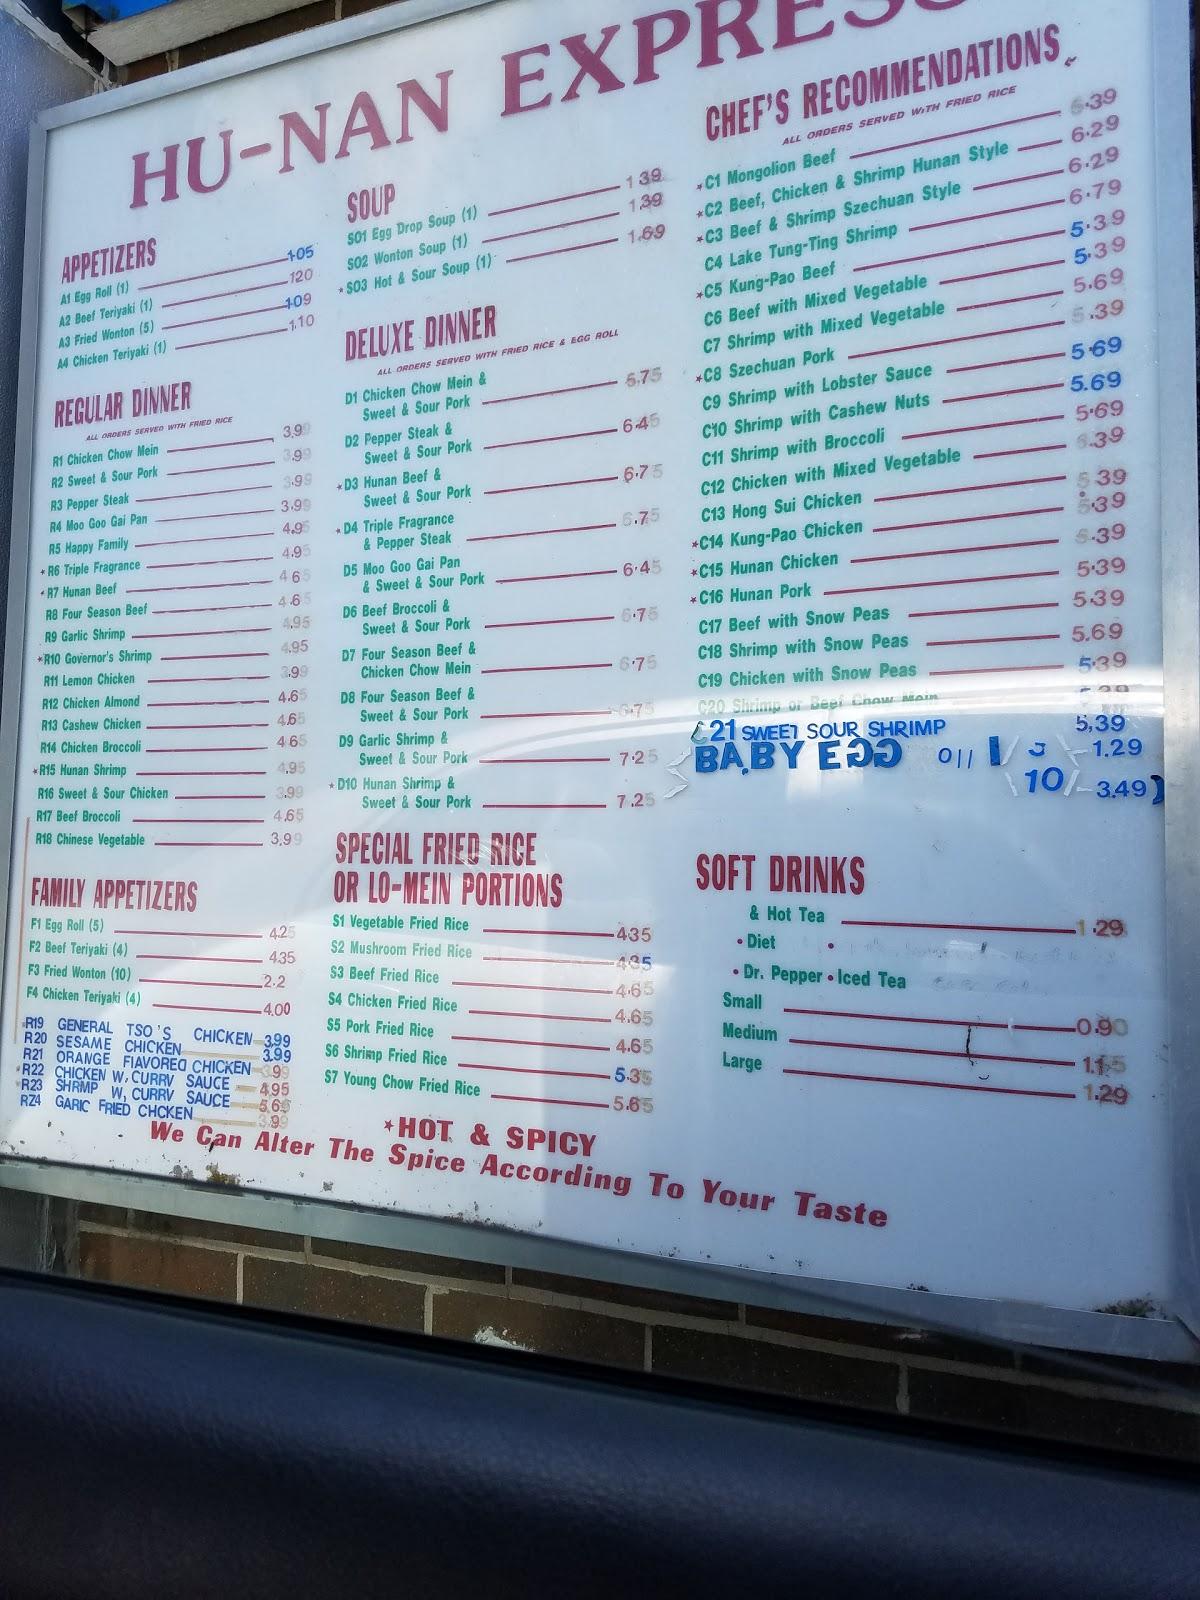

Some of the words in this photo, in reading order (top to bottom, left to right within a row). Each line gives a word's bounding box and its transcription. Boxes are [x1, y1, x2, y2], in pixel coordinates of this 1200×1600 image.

[706, 88, 790, 142] CHEF'S
[803, 23, 1060, 120] RECOMMENDATIONS
[782, 135, 801, 146] ALL
[807, 122, 853, 140] ORDERS
[858, 111, 905, 128] SERVED
[945, 93, 982, 108] FRIED
[987, 85, 1017, 99] RICE
[130, 69, 454, 209] HU-NAN
[347, 183, 396, 224] SOUP
[61, 237, 157, 284] APPETIZERS
[705, 255, 723, 272] C4
[730, 249, 762, 267] Lake
[769, 235, 838, 259] Tung-Ting
[846, 224, 898, 244] Shrimp
[374, 274, 392, 290] Hot
[398, 271, 405, 285] &
[411, 268, 436, 282] Sour
[442, 262, 470, 276] Soup
[476, 252, 492, 271] (1)
[60, 292, 70, 305] A1
[74, 291, 91, 304] Egg
[95, 285, 112, 299] Roll
[116, 280, 129, 296] (1)
[58, 336, 70, 349] A3
[74, 331, 98, 346] Fried
[102, 327, 135, 341] Wonton
[139, 320, 154, 335] (5)
[345, 319, 414, 362] DELUXE
[424, 305, 497, 350] DINNER
[703, 337, 721, 354] C7
[728, 331, 776, 350] Shrimp
[783, 322, 814, 340] with
[821, 312, 863, 334] Mixed
[870, 300, 944, 326] Vegetable
[57, 357, 69, 370] A4
[73, 353, 109, 367] Chicken
[113, 343, 149, 361] Teriyaki
[153, 340, 166, 356] (1)
[377, 368, 392, 376] ALL
[396, 361, 431, 372] ORDERS
[436, 355, 471, 367] SERVED
[475, 350, 498, 360] WITH
[501, 345, 528, 357] FRIED
[532, 340, 556, 351] RICE
[559, 338, 565, 347] &
[570, 334, 591, 344] EGG
[595, 329, 619, 340] ROLL
[345, 391, 358, 405] D1
[363, 386, 406, 403] Chicken
[411, 381, 441, 396] Chow
[447, 374, 473, 390] Mein
[479, 371, 486, 386] &
[702, 394, 721, 411] C9
[728, 388, 776, 407] Shrimp
[784, 380, 815, 398] with
[822, 372, 878, 392] Lobster
[885, 365, 933, 383] Sauce
[54, 391, 124, 428] REGULAR
[132, 381, 192, 418] DINNER
[362, 405, 396, 422] Sweet
[402, 402, 409, 416] &
[415, 400, 440, 414] Sour
[446, 394, 470, 410] Pork
[101, 429, 132, 439] ORDERS
[134, 425, 164, 435] SERVED
[167, 422, 187, 431] WITH
[189, 419, 212, 428] FRIED
[214, 416, 233, 424] RICE
[52, 455, 63, 468] R1
[67, 452, 103, 466] Chicken
[107, 448, 133, 461] Chow
[137, 444, 159, 457] Mein
[50, 521, 62, 533] R4
[66, 519, 84, 531] Moo
[88, 517, 106, 529] Goo
[110, 514, 126, 527] Gai
[130, 513, 148, 525] Pan
[699, 618, 722, 634] C17
[729, 615, 760, 632] Beef
[768, 612, 798, 629] with
[806, 610, 845, 626] Snow
[853, 606, 890, 622] Peas
[41, 719, 58, 731] R13
[62, 718, 99, 731] Cashew
[103, 717, 141, 730] Chicken
[808, 720, 860, 738] SOUR
[868, 719, 946, 738] SHRIMP
[335, 832, 413, 865] SPECIAL
[422, 832, 480, 865] FRIED
[490, 832, 537, 866] RICE
[333, 870, 359, 903] OR
[368, 871, 451, 904] LO-MEIN
[462, 873, 563, 908] PORTIONS
[696, 854, 756, 892] SOFT
[769, 855, 865, 896] DRINKS
[31, 877, 86, 908] FAMILY
[93, 879, 198, 912] APPETIZERS
[750, 904, 759, 921] &
[767, 906, 792, 922] Hot
[798, 906, 824, 923] Tea
[747, 933, 776, 950] Diet
[744, 963, 764, 980] Dr.
[772, 965, 823, 985] Pepper
[838, 968, 871, 987] Iced
[877, 971, 906, 989] Tea
[27, 986, 39, 998] F4
[42, 986, 79, 1001] Chicken
[83, 989, 121, 1006] Teriyaki
[126, 991, 142, 1007] (4)
[328, 991, 342, 1006] S4
[348, 992, 392, 1008] Chicken
[398, 995, 426, 1010] Fried
[432, 997, 457, 1012] Rice
[722, 991, 762, 1010] Small
[24, 1031, 47, 1044] R20
[56, 1036, 112, 1051] SESAME
[125, 1040, 182, 1056] CHICKEN
[723, 1022, 778, 1041] Medium
[722, 1051, 762, 1074] Large
[99, 1100, 131, 1117] FRIED
[398, 1116, 453, 1143] HOT
[470, 1123, 490, 1147] &
[506, 1126, 597, 1157] SPICY
[151, 1120, 184, 1143] We
[196, 1124, 242, 1149] Can
[254, 1131, 315, 1156] Alter
[329, 1137, 374, 1162] The
[388, 1143, 465, 1173] Spice
[480, 1153, 632, 1197] According
[648, 1171, 685, 1200] To
[703, 1178, 775, 1212] Your
[794, 1191, 888, 1228] Taste
